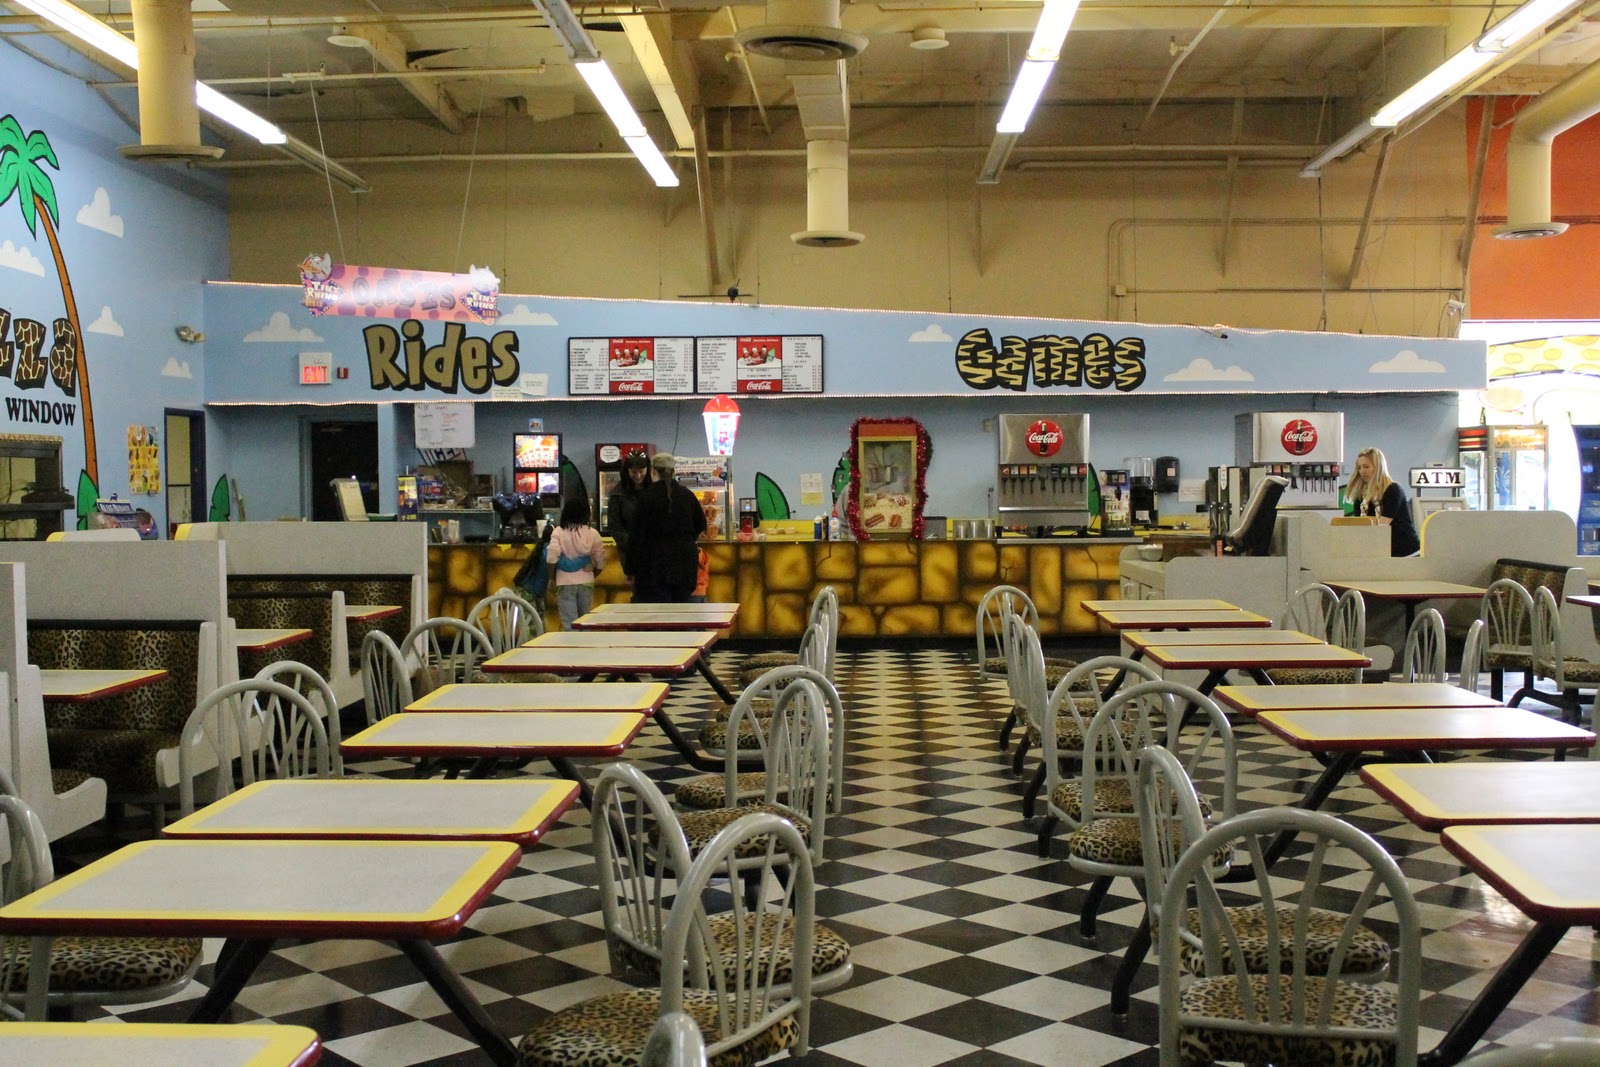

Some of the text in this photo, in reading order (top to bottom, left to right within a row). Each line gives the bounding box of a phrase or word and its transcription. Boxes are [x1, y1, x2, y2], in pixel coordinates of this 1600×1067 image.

[306, 287, 338, 300] RHINO
[311, 281, 340, 296] TINY
[467, 297, 495, 310] RHINO
[471, 292, 496, 303] TINY
[362, 319, 520, 394] Rides
[303, 365, 328, 382] EXIT
[5, 397, 76, 426] WINDOW
[1029, 432, 1059, 443] Coca-Cola
[1284, 430, 1317, 442] Coca-Cola
[1416, 471, 1461, 484] ATM
